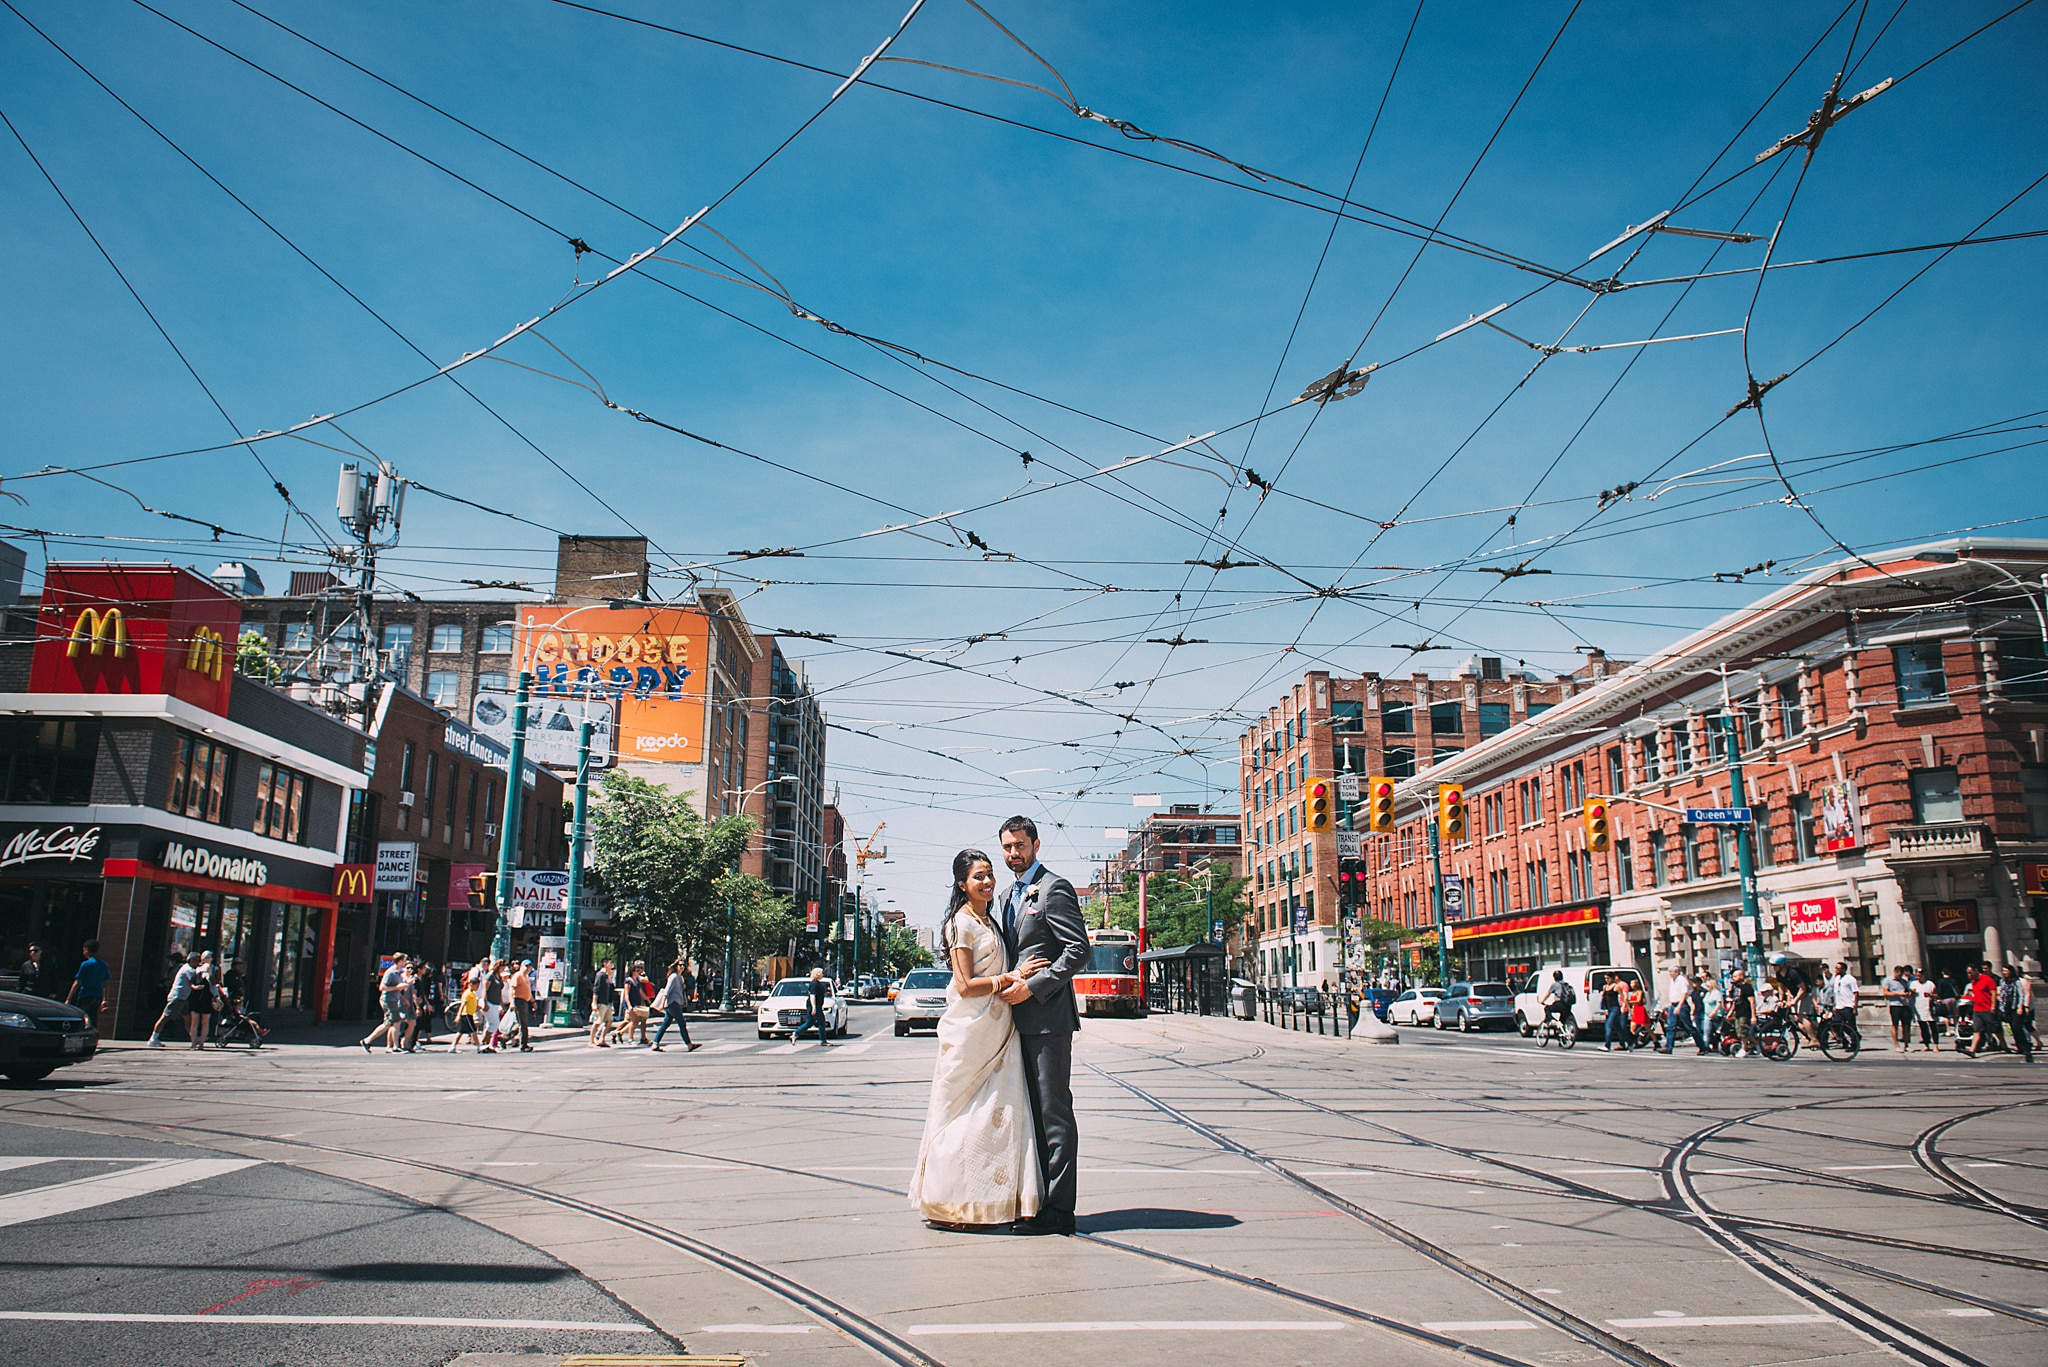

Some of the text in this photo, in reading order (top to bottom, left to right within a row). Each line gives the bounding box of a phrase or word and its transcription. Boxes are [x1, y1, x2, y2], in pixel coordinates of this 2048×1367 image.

[537, 633, 691, 664] CHOOSE
[536, 664, 692, 701] HAPPY
[445, 725, 469, 752] street
[1695, 810, 1726, 820] Queen
[1733, 809, 1742, 819] W
[1337, 834, 1359, 842] TRANSIT
[3, 826, 100, 863] McCafé
[1339, 845, 1358, 853] SIGNAL
[379, 850, 411, 859] STREET
[163, 841, 268, 887] McDonald's
[377, 861, 410, 872] DANCE
[376, 875, 409, 883] ACADEMY
[534, 874, 569, 884] AMAZING
[513, 887, 569, 901] NAILS
[1802, 903, 1822, 917] Open
[1938, 908, 1964, 919] CIBC
[1791, 916, 1838, 936] Saturdays!
[1943, 935, 1964, 943] 378
